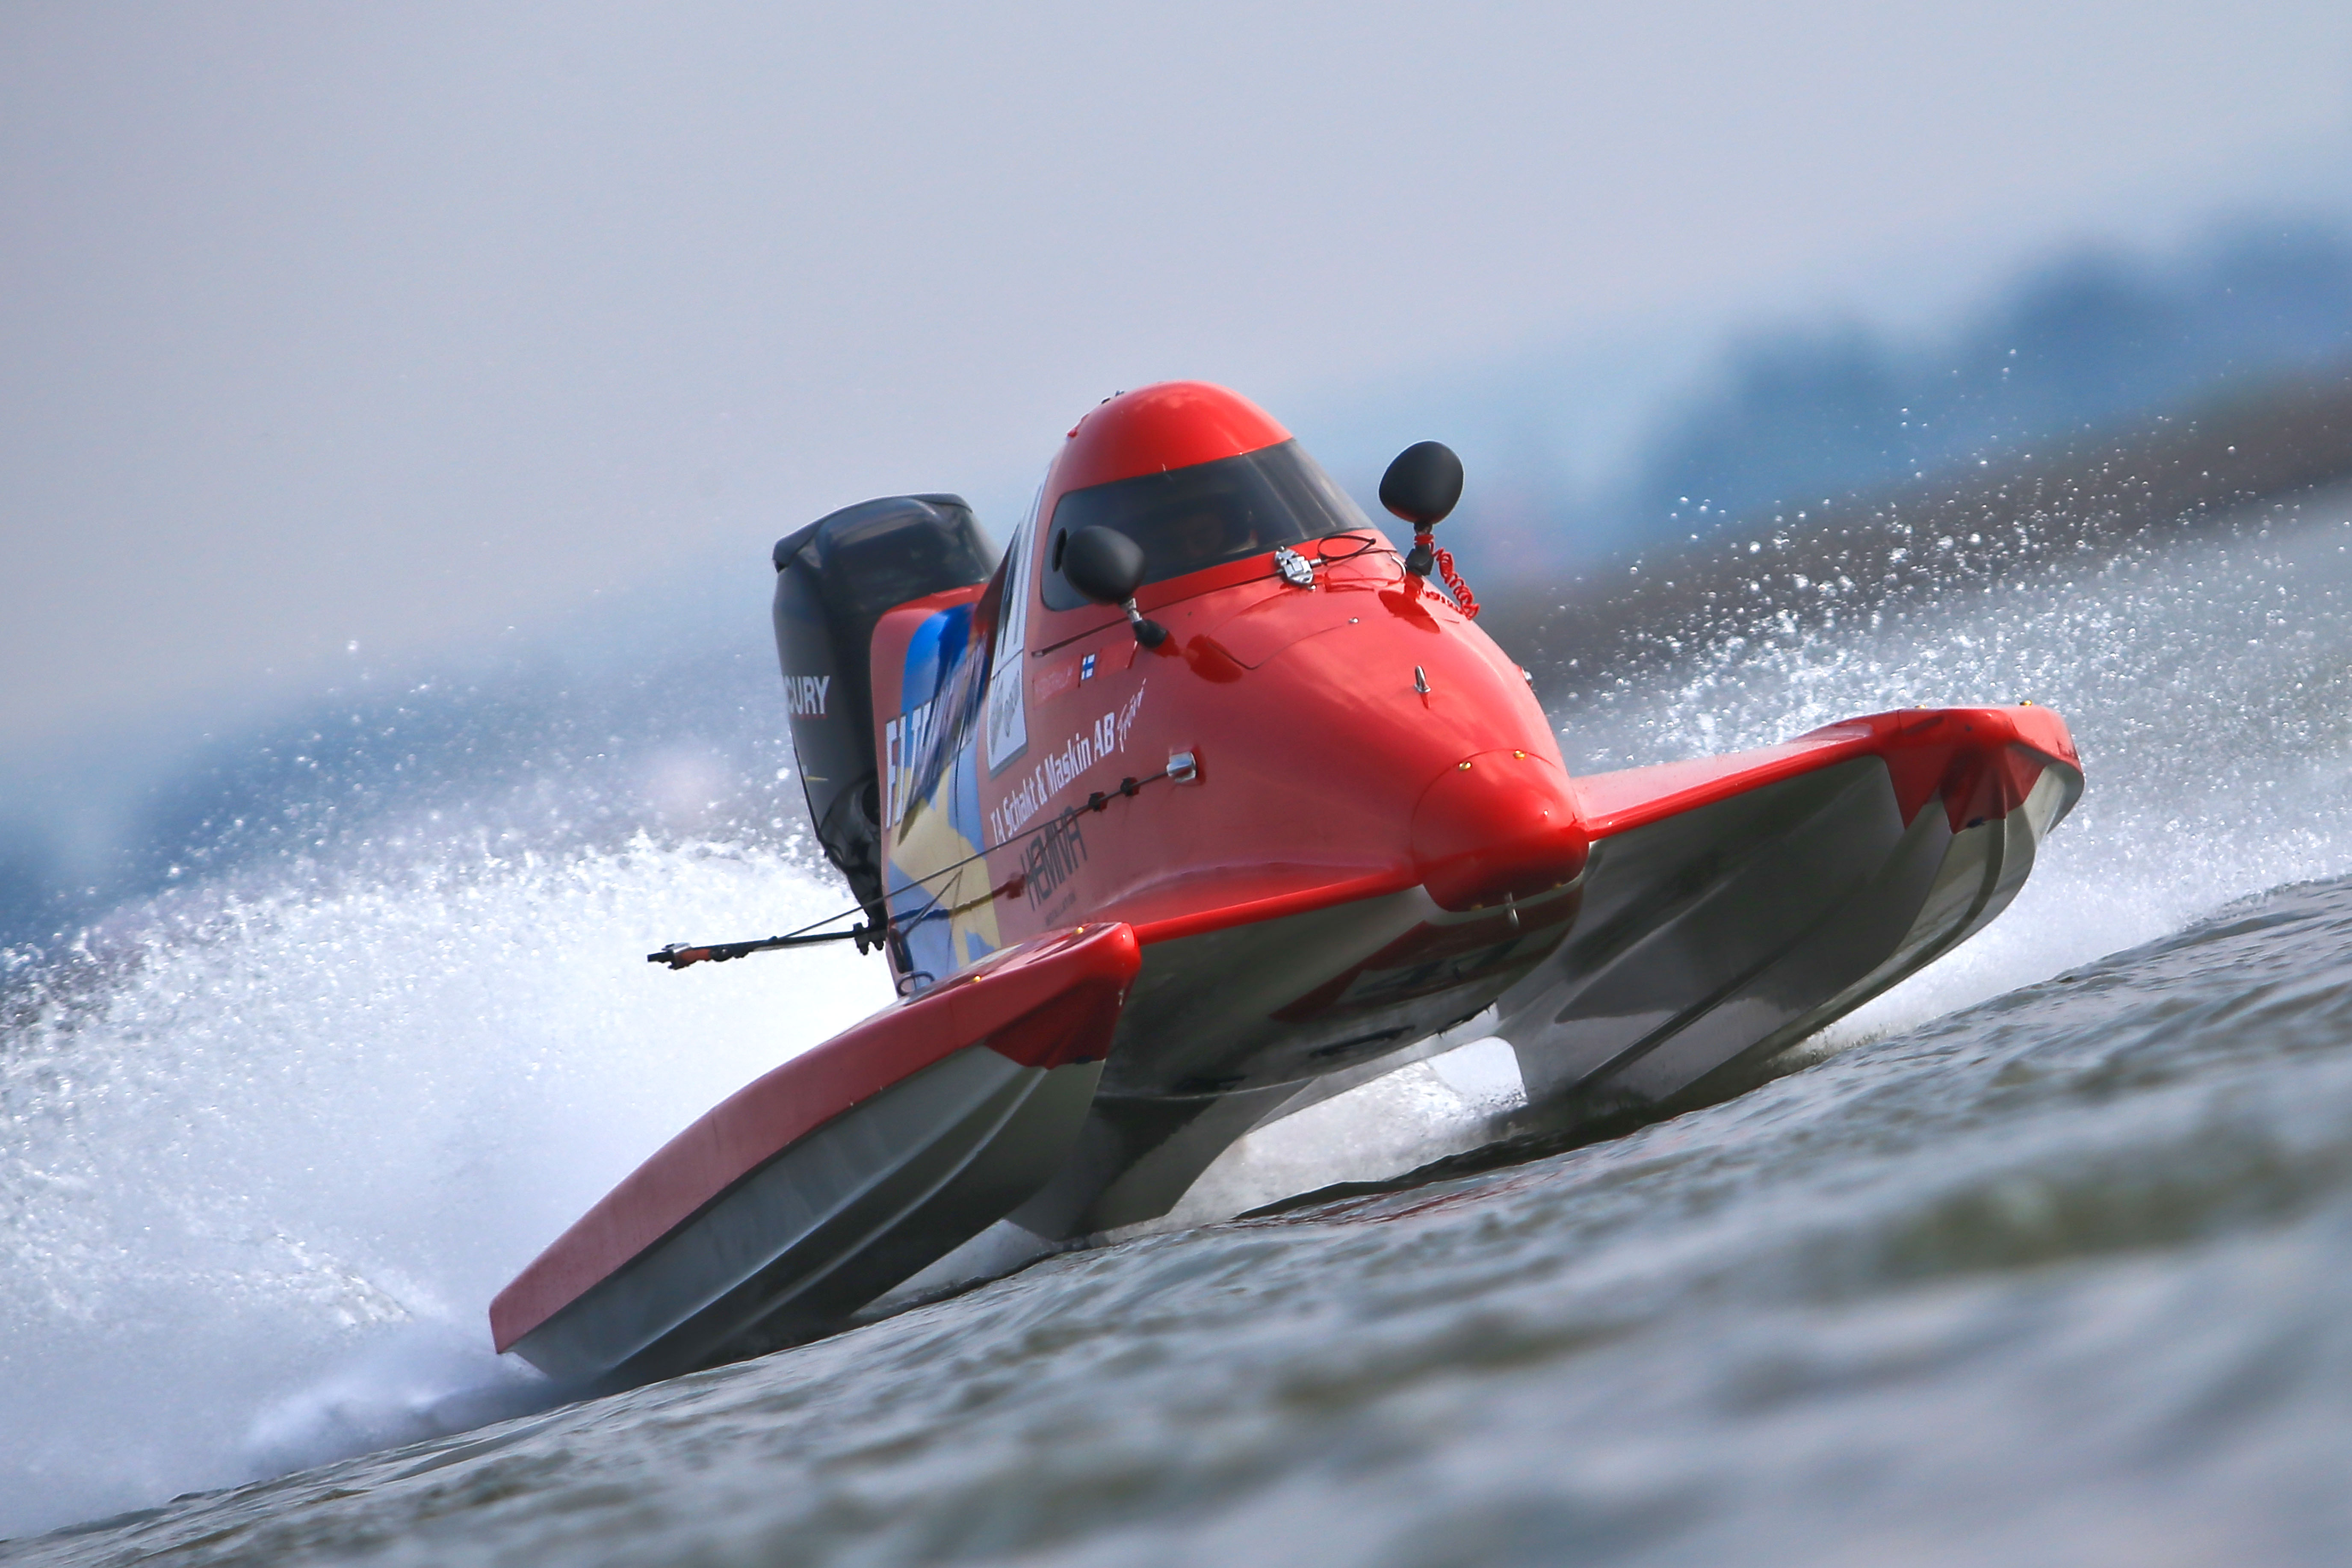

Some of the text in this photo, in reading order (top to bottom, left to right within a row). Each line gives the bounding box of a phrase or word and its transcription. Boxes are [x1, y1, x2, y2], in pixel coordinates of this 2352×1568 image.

[1003, 777, 1039, 838] Schakt
[1035, 764, 1048, 805] &
[1044, 732, 1092, 797] Maskin
[1093, 712, 1115, 762] AB
